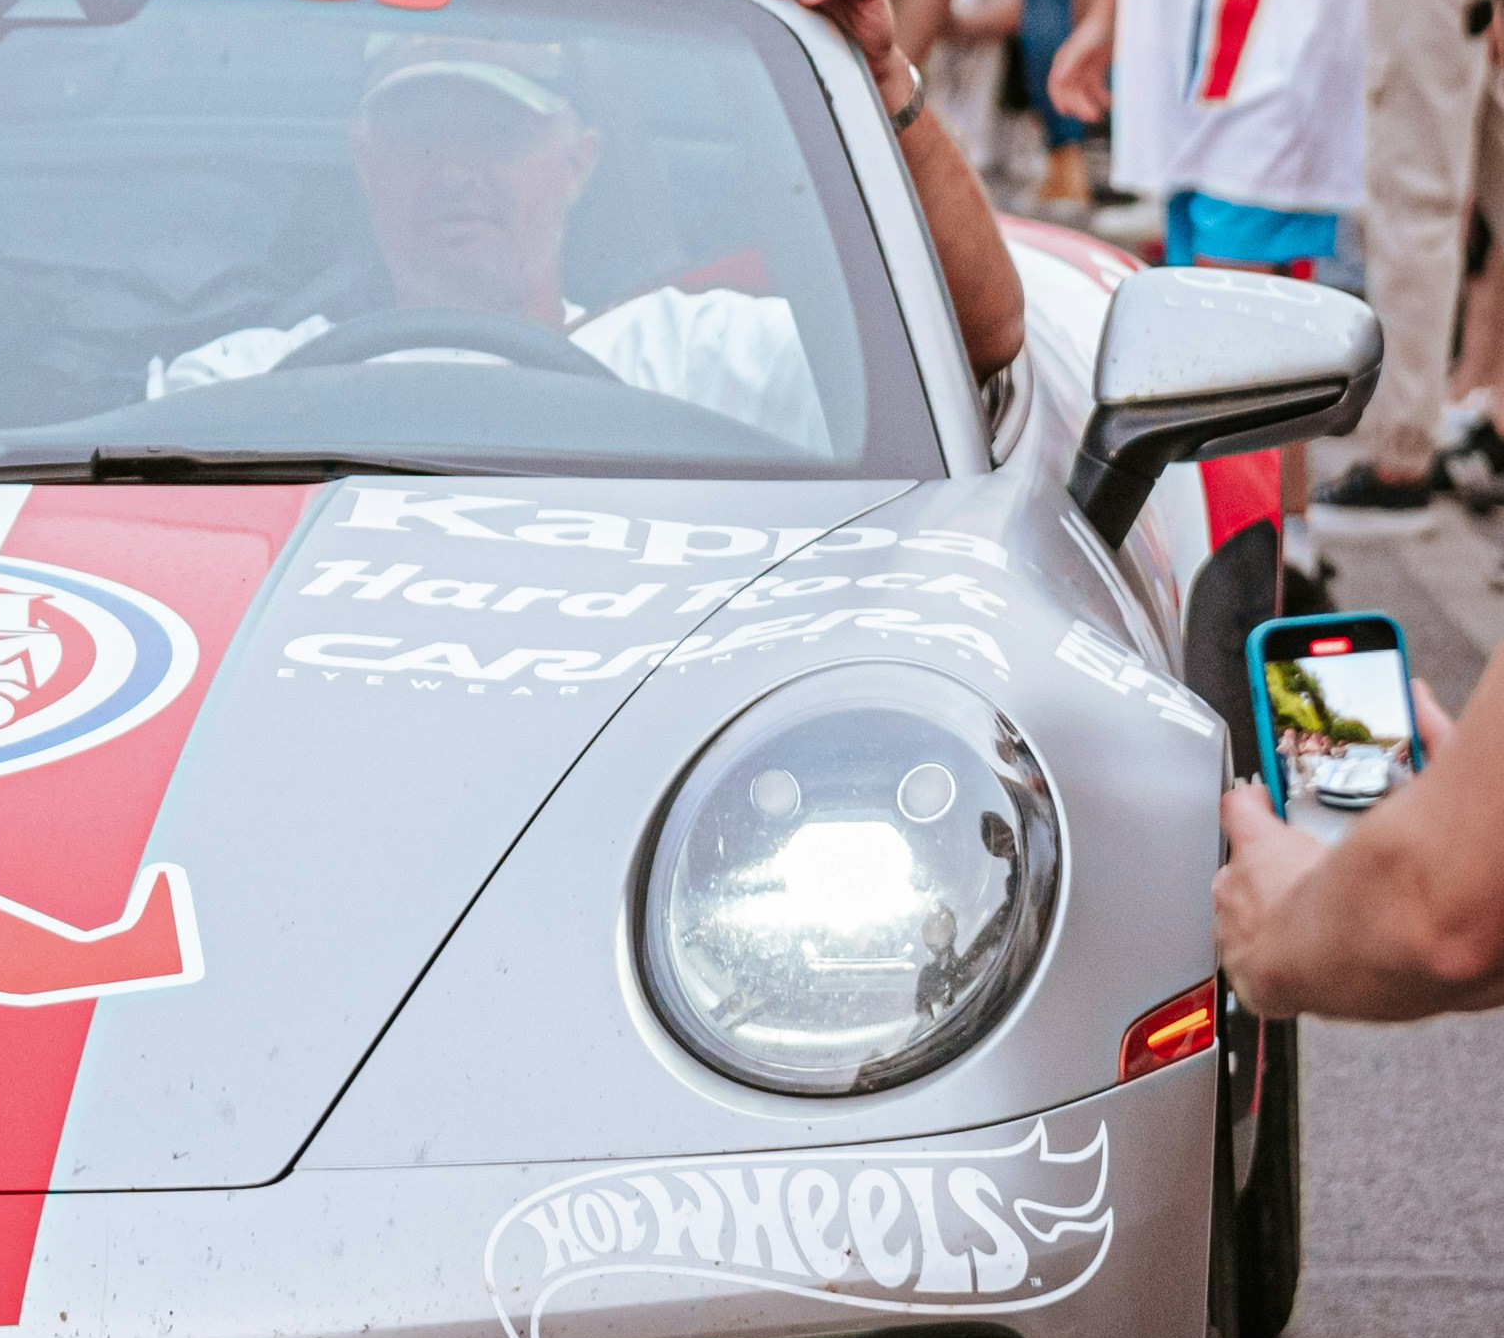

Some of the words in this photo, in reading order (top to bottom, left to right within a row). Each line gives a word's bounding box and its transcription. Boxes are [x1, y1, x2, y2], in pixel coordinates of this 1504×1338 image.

[334, 486, 1018, 577] Kappa
[298, 559, 668, 618] Hard
[673, 572, 1008, 619] Rock
[276, 666, 580, 696] EYEWEAR
[283, 607, 1012, 681] CARRERA
[521, 1187, 649, 1277] HOT
[622, 1167, 1029, 1294] WHEELS
